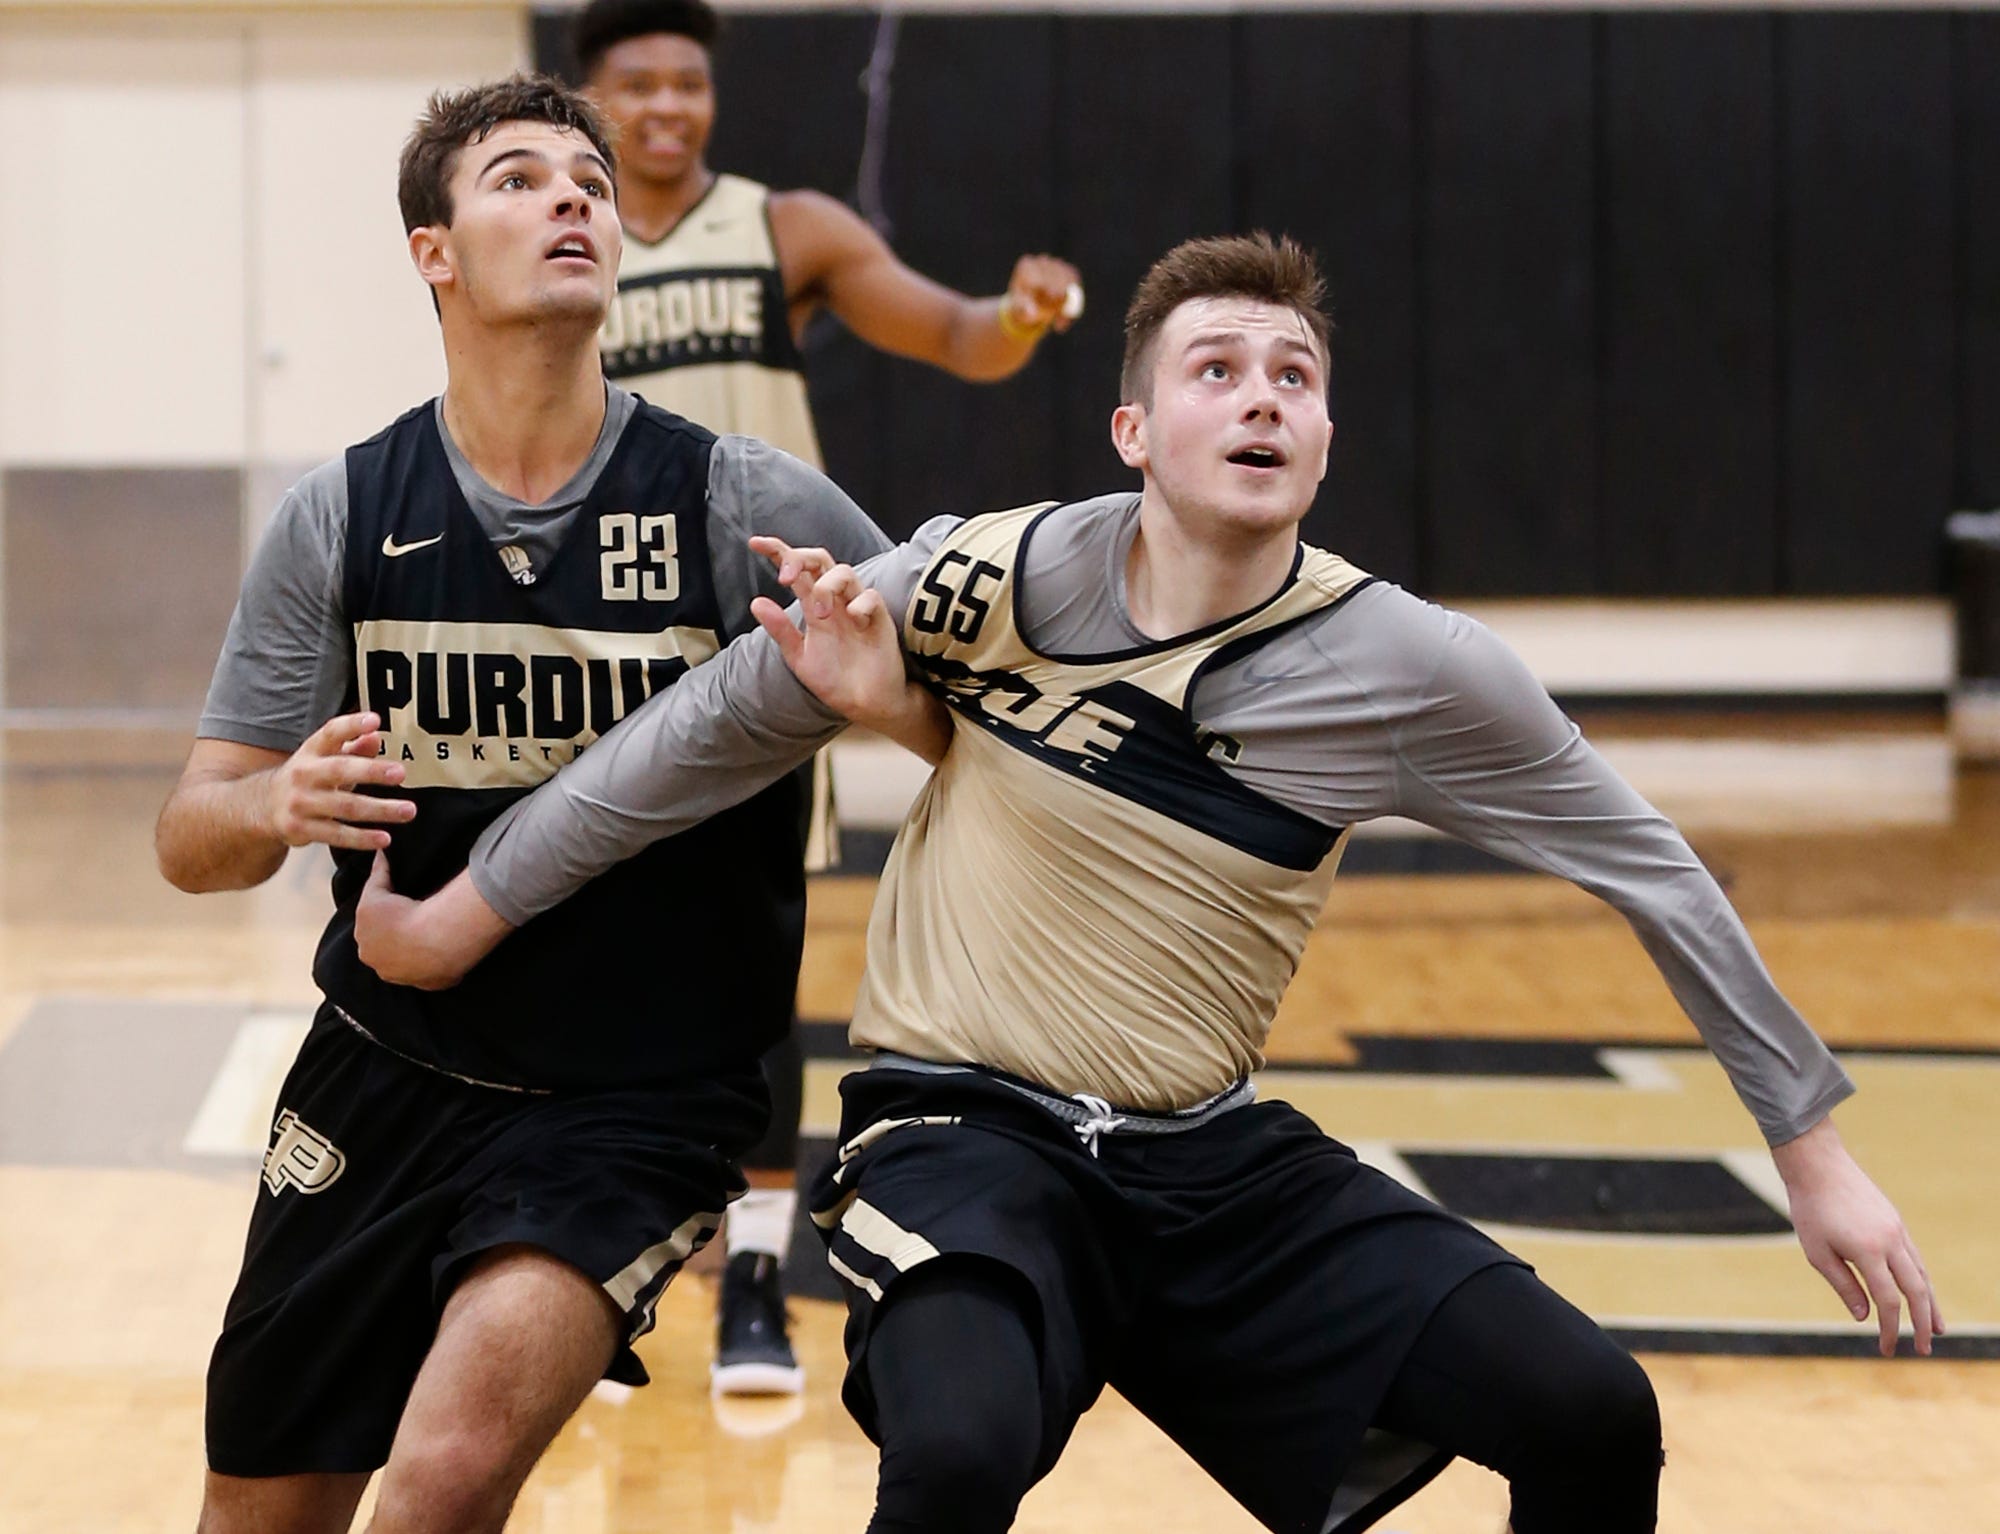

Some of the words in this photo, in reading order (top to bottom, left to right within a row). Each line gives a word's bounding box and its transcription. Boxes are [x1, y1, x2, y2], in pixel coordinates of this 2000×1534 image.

[597, 276, 763, 349] URDUE
[599, 513, 680, 601] 23
[911, 549, 1005, 645] 55
